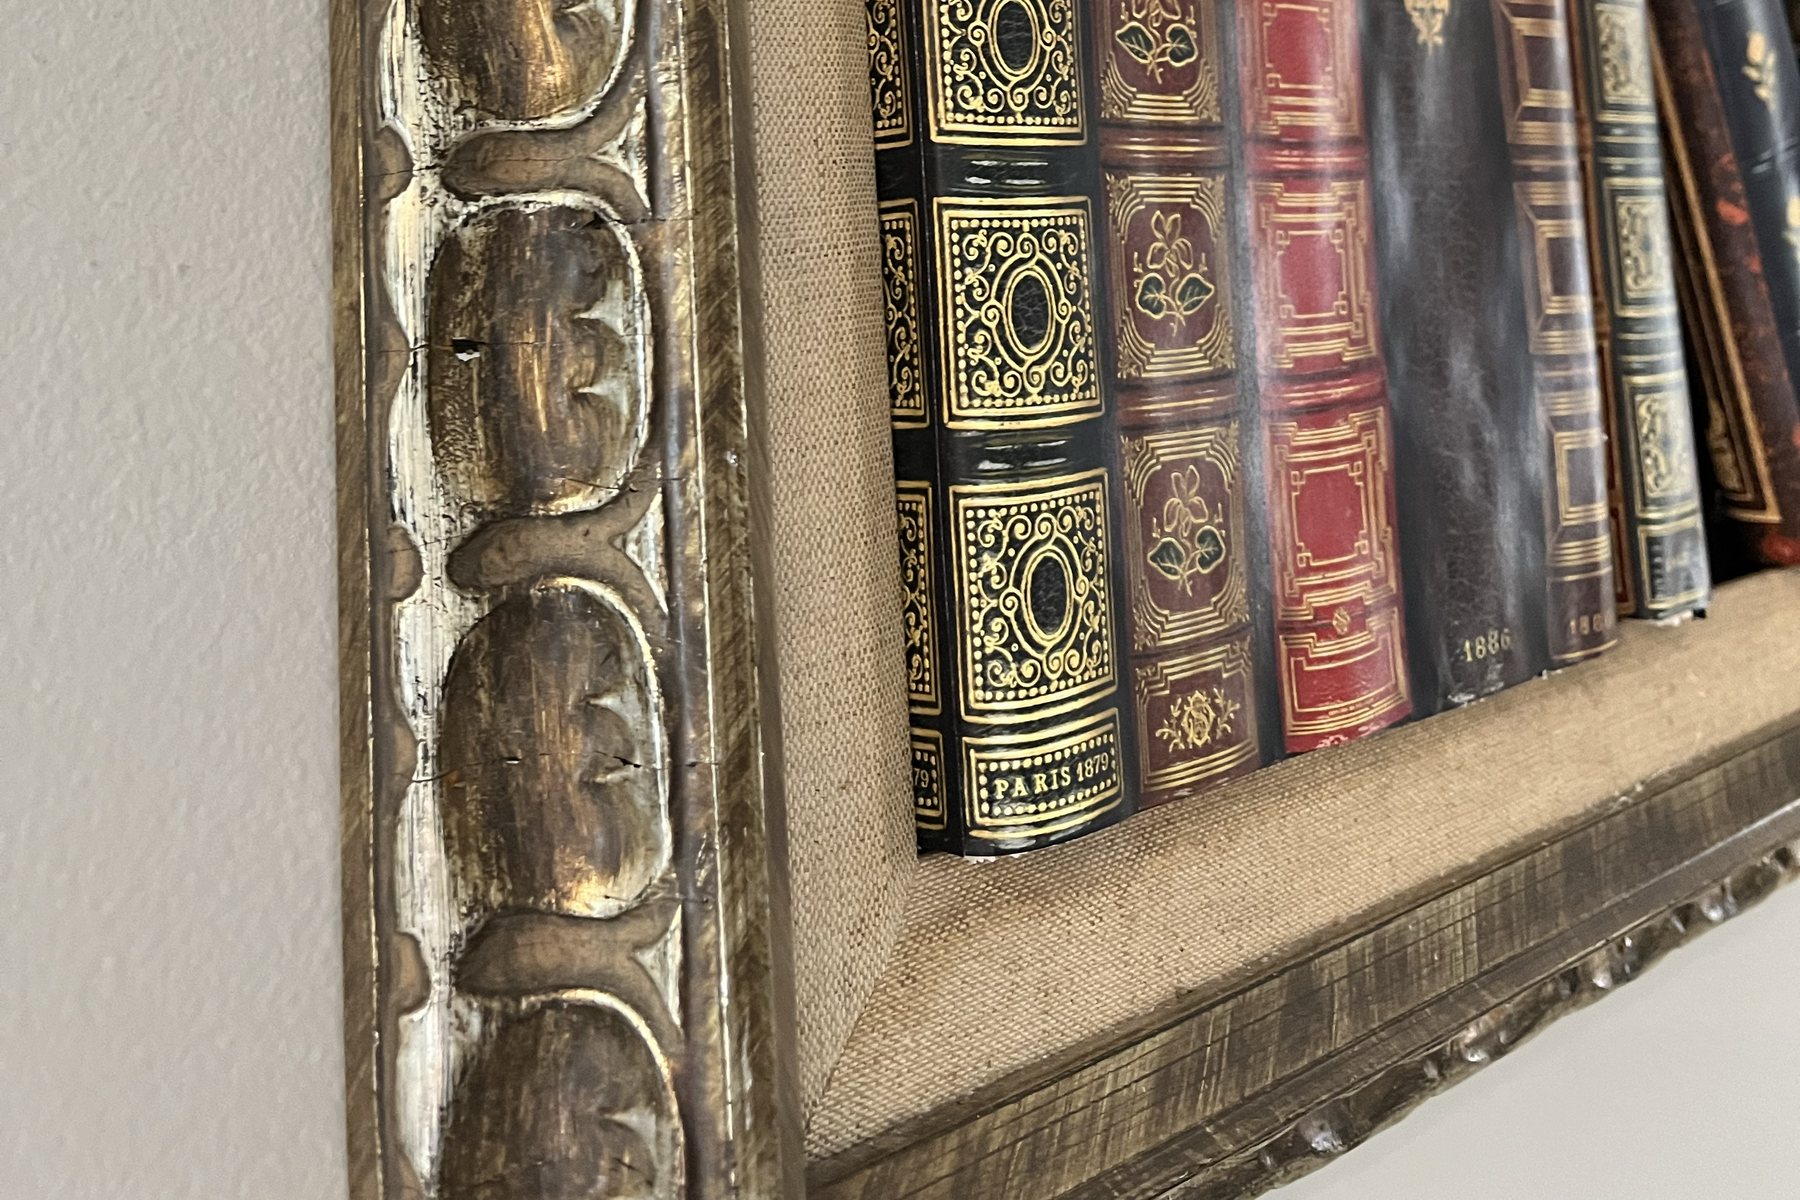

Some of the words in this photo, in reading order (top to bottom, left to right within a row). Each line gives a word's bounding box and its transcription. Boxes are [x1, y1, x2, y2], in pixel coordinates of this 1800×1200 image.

[1463, 627, 1511, 662] 1886
[994, 766, 1072, 800] PARIS
[1077, 752, 1110, 783] 1879
